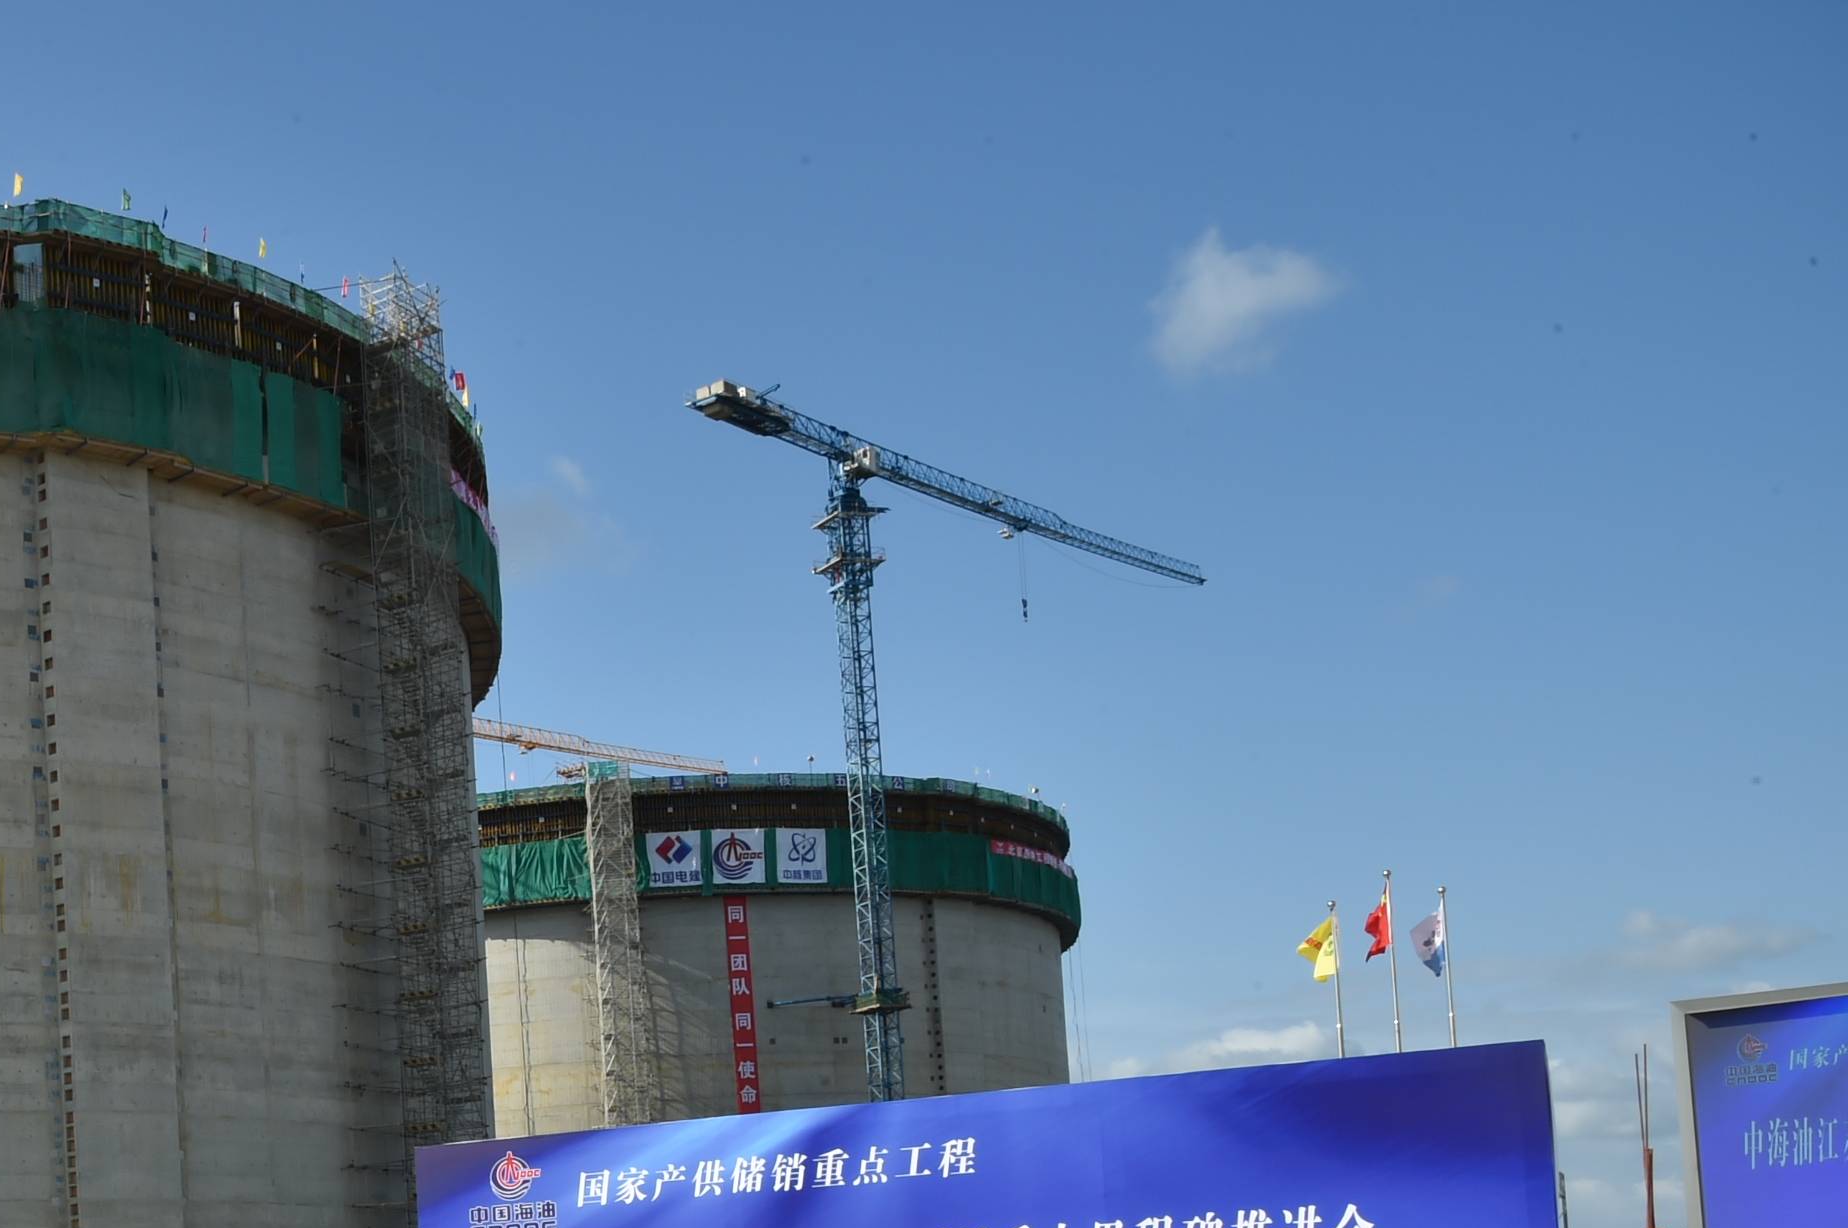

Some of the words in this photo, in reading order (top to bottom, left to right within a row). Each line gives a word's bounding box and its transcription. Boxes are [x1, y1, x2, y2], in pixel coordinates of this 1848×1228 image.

[649, 871, 701, 885] 中国电建
[727, 905, 750, 996] 同一团队
[735, 1012, 757, 1104] 同一使命
[577, 1136, 977, 1208] 国家产供储销重点工程
[1744, 1116, 1848, 1170] 中海油江
[469, 1200, 557, 1224] 中国海油
